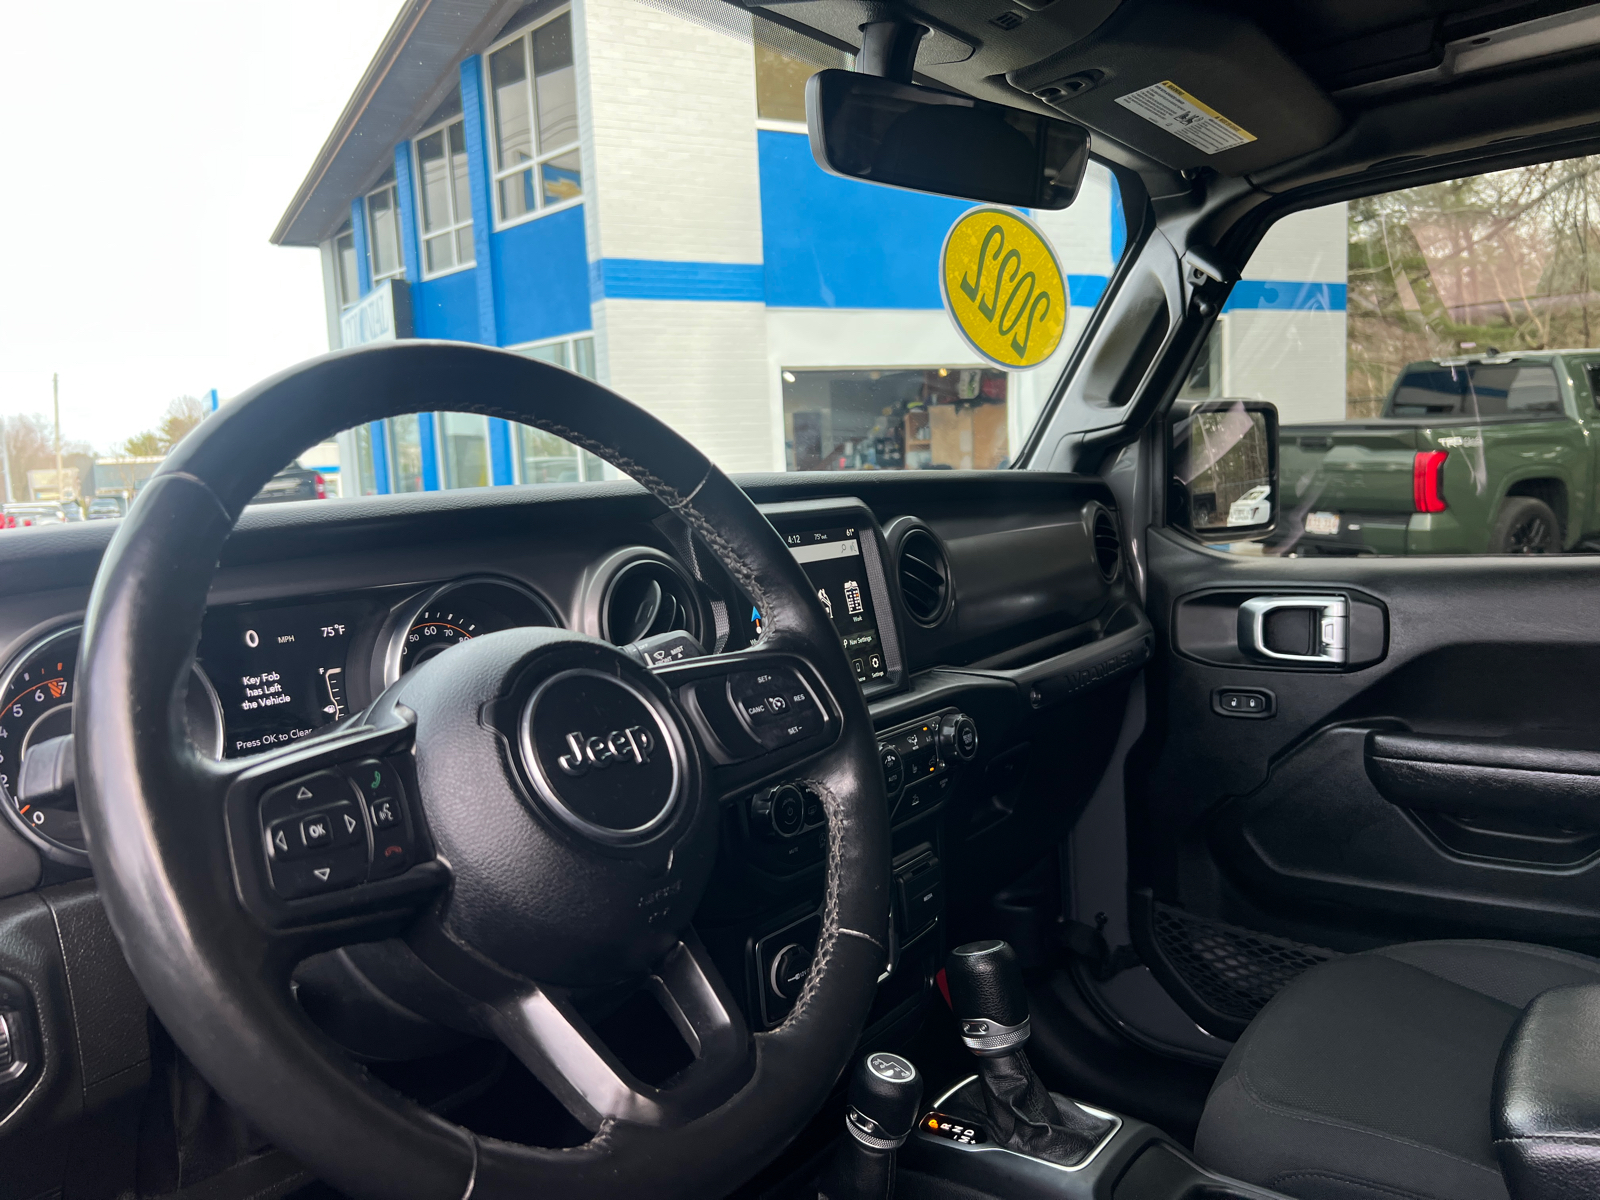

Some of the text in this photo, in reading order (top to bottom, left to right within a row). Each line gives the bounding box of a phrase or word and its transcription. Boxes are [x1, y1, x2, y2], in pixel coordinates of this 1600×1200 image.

[787, 534, 801, 545] 4:12
[320, 623, 346, 638] 75°F
[424, 626, 437, 636] 60
[443, 629, 454, 637] 70
[245, 629, 295, 648] 0 MPH
[409, 634, 420, 643] 50
[670, 645, 685, 656] MIST
[242, 671, 280, 686] Key Fob
[1064, 650, 1135, 693] WRANGLER
[59, 682, 67, 694] 7
[246, 683, 283, 698] has Left
[34, 690, 45, 702] 6
[241, 694, 291, 711] the Vehicle
[793, 693, 806, 702] RES
[12, 704, 23, 717] 5
[748, 704, 765, 715] CANC
[236, 728, 313, 750] Press OK to Clear
[557, 725, 655, 776] Jeep
[33, 810, 45, 824] 0
[308, 823, 327, 838] OK
[940, 1123, 952, 1131] R
[963, 1129, 975, 1137] D
